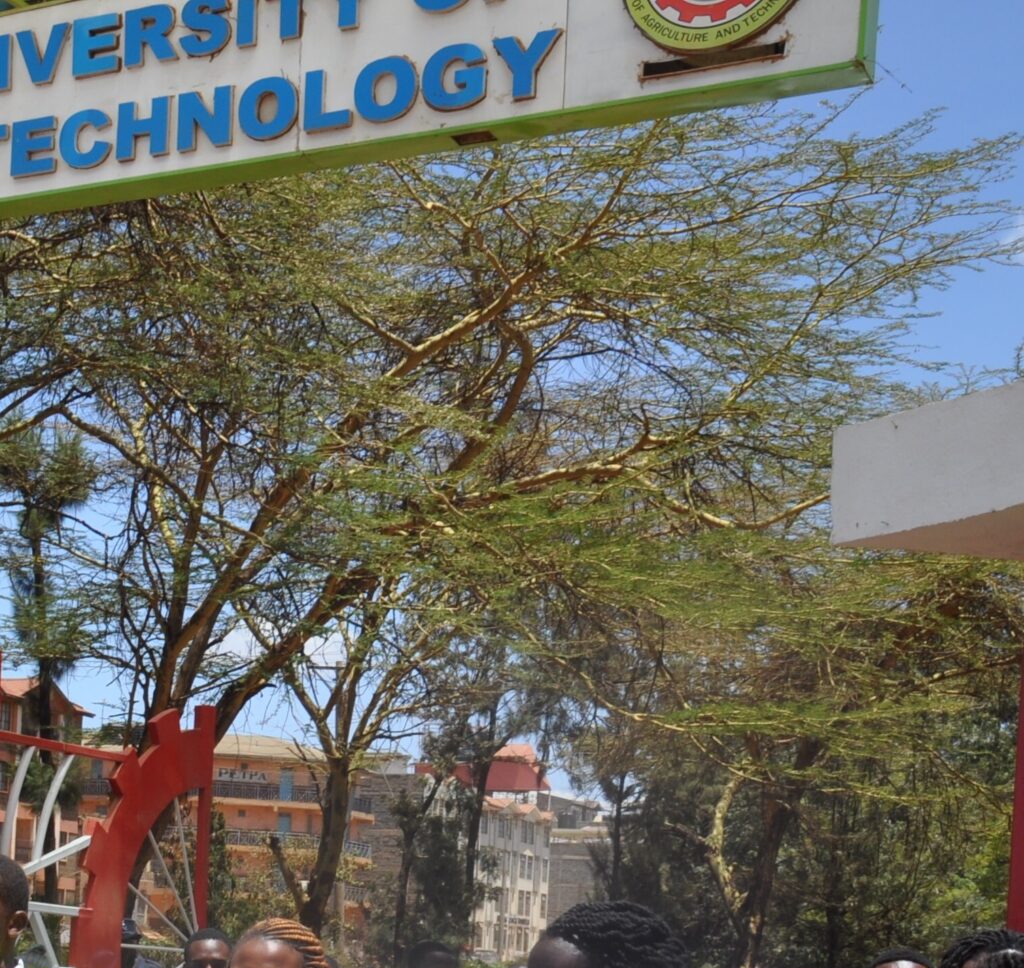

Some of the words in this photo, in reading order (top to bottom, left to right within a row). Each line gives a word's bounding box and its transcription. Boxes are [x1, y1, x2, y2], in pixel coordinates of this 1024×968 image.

[631, 0, 643, 13] OF
[640, 13, 710, 44] AGRICULTURE
[715, 23, 742, 40] AND
